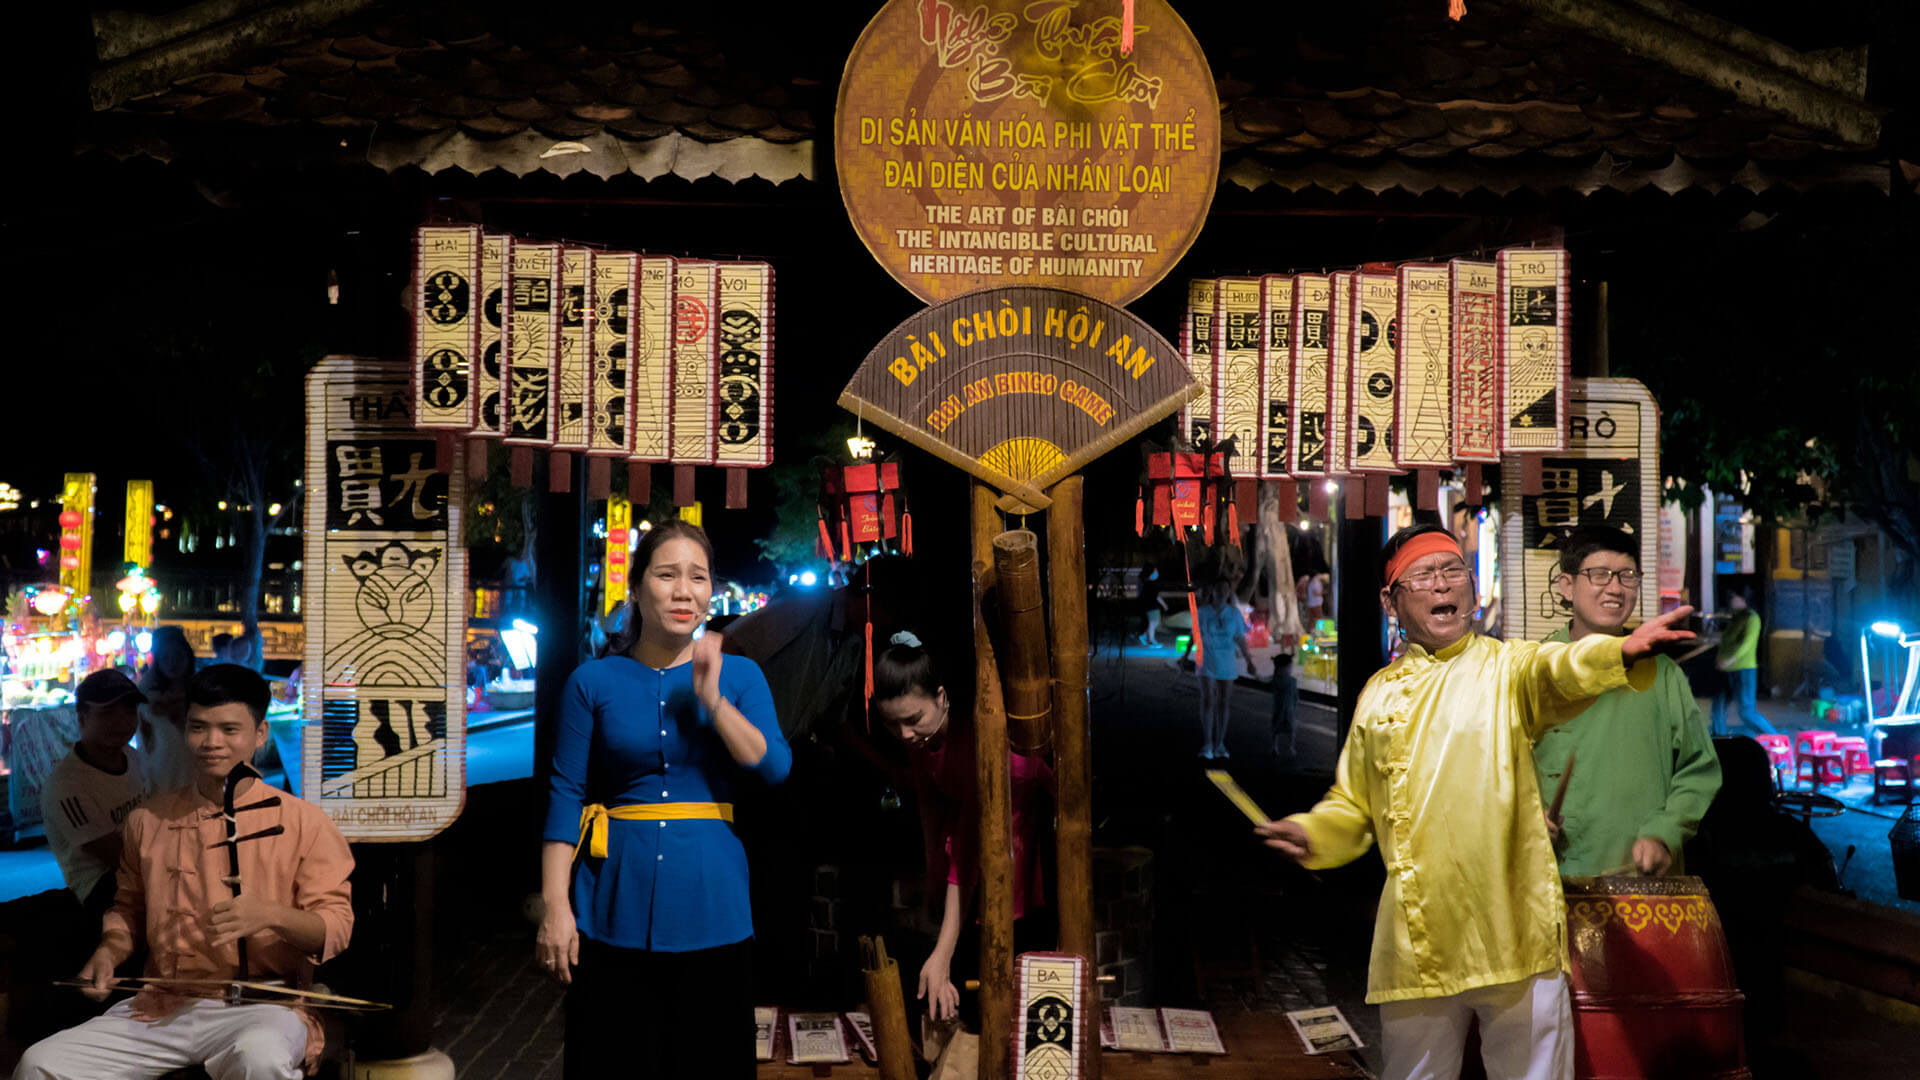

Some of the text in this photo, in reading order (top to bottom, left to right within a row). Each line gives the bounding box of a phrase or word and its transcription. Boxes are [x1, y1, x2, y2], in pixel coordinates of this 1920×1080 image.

[861, 107, 1196, 156] DI SẢN VĂN HÓA PHI VẬT THỂ
[885, 152, 1171, 198] ĐẠI DIỆN CỦA NHÂN LOẠI
[926, 205, 1130, 228] THE ART OF BÀI CHÒI
[434, 239, 458, 252] HAI
[482, 242, 499, 261] ỀN
[896, 229, 1157, 253] THE INTANGIBLE CULTURAL
[515, 251, 548, 270] UYẾT
[909, 255, 1145, 277] HERITAGE OF HUMANITY
[722, 278, 747, 291] VOI
[887, 299, 1157, 388] BÀI CHÒI HỘI AN
[963, 377, 994, 407] AN
[994, 371, 1057, 396] BINGO
[1060, 379, 1116, 426] GAME
[1569, 410, 1617, 440] RÒ
[1037, 969, 1060, 983] BA
